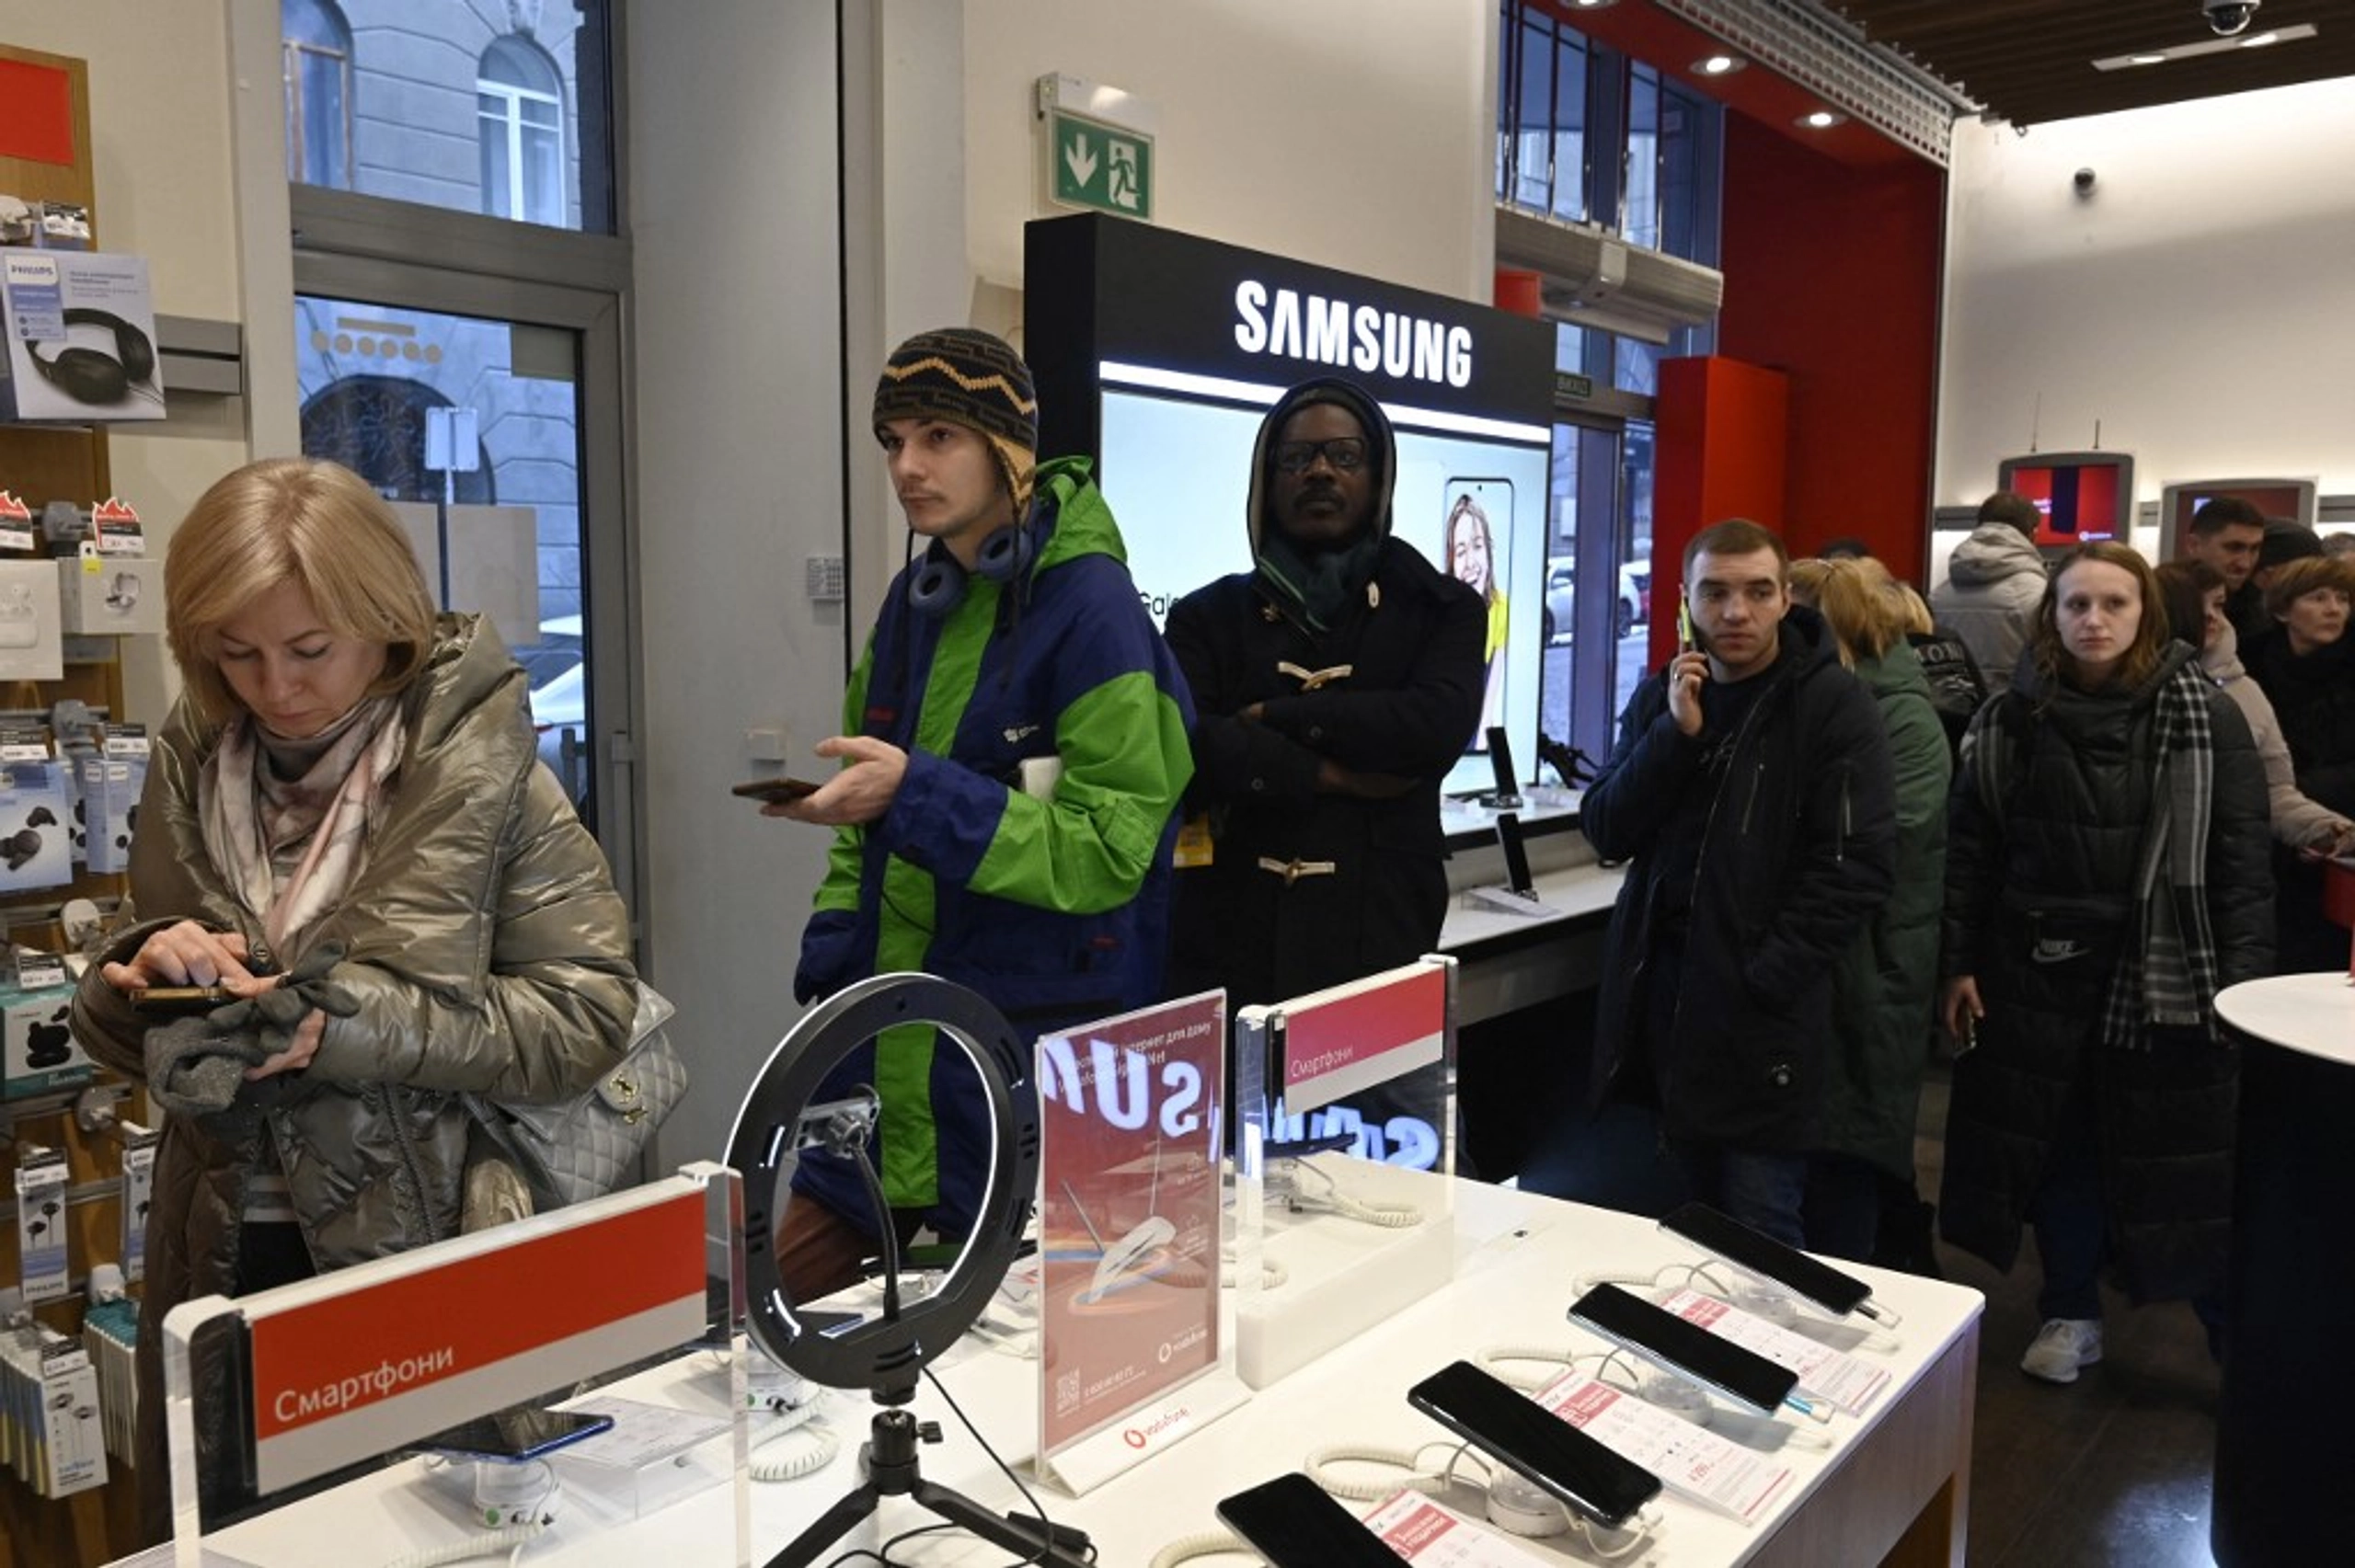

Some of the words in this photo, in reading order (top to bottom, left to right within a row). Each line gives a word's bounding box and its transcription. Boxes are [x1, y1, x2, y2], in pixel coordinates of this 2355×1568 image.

[1235, 280, 1472, 388] SAMSUNG
[1291, 1046, 1354, 1078] Смартфони
[274, 1345, 454, 1422] Смартфони
